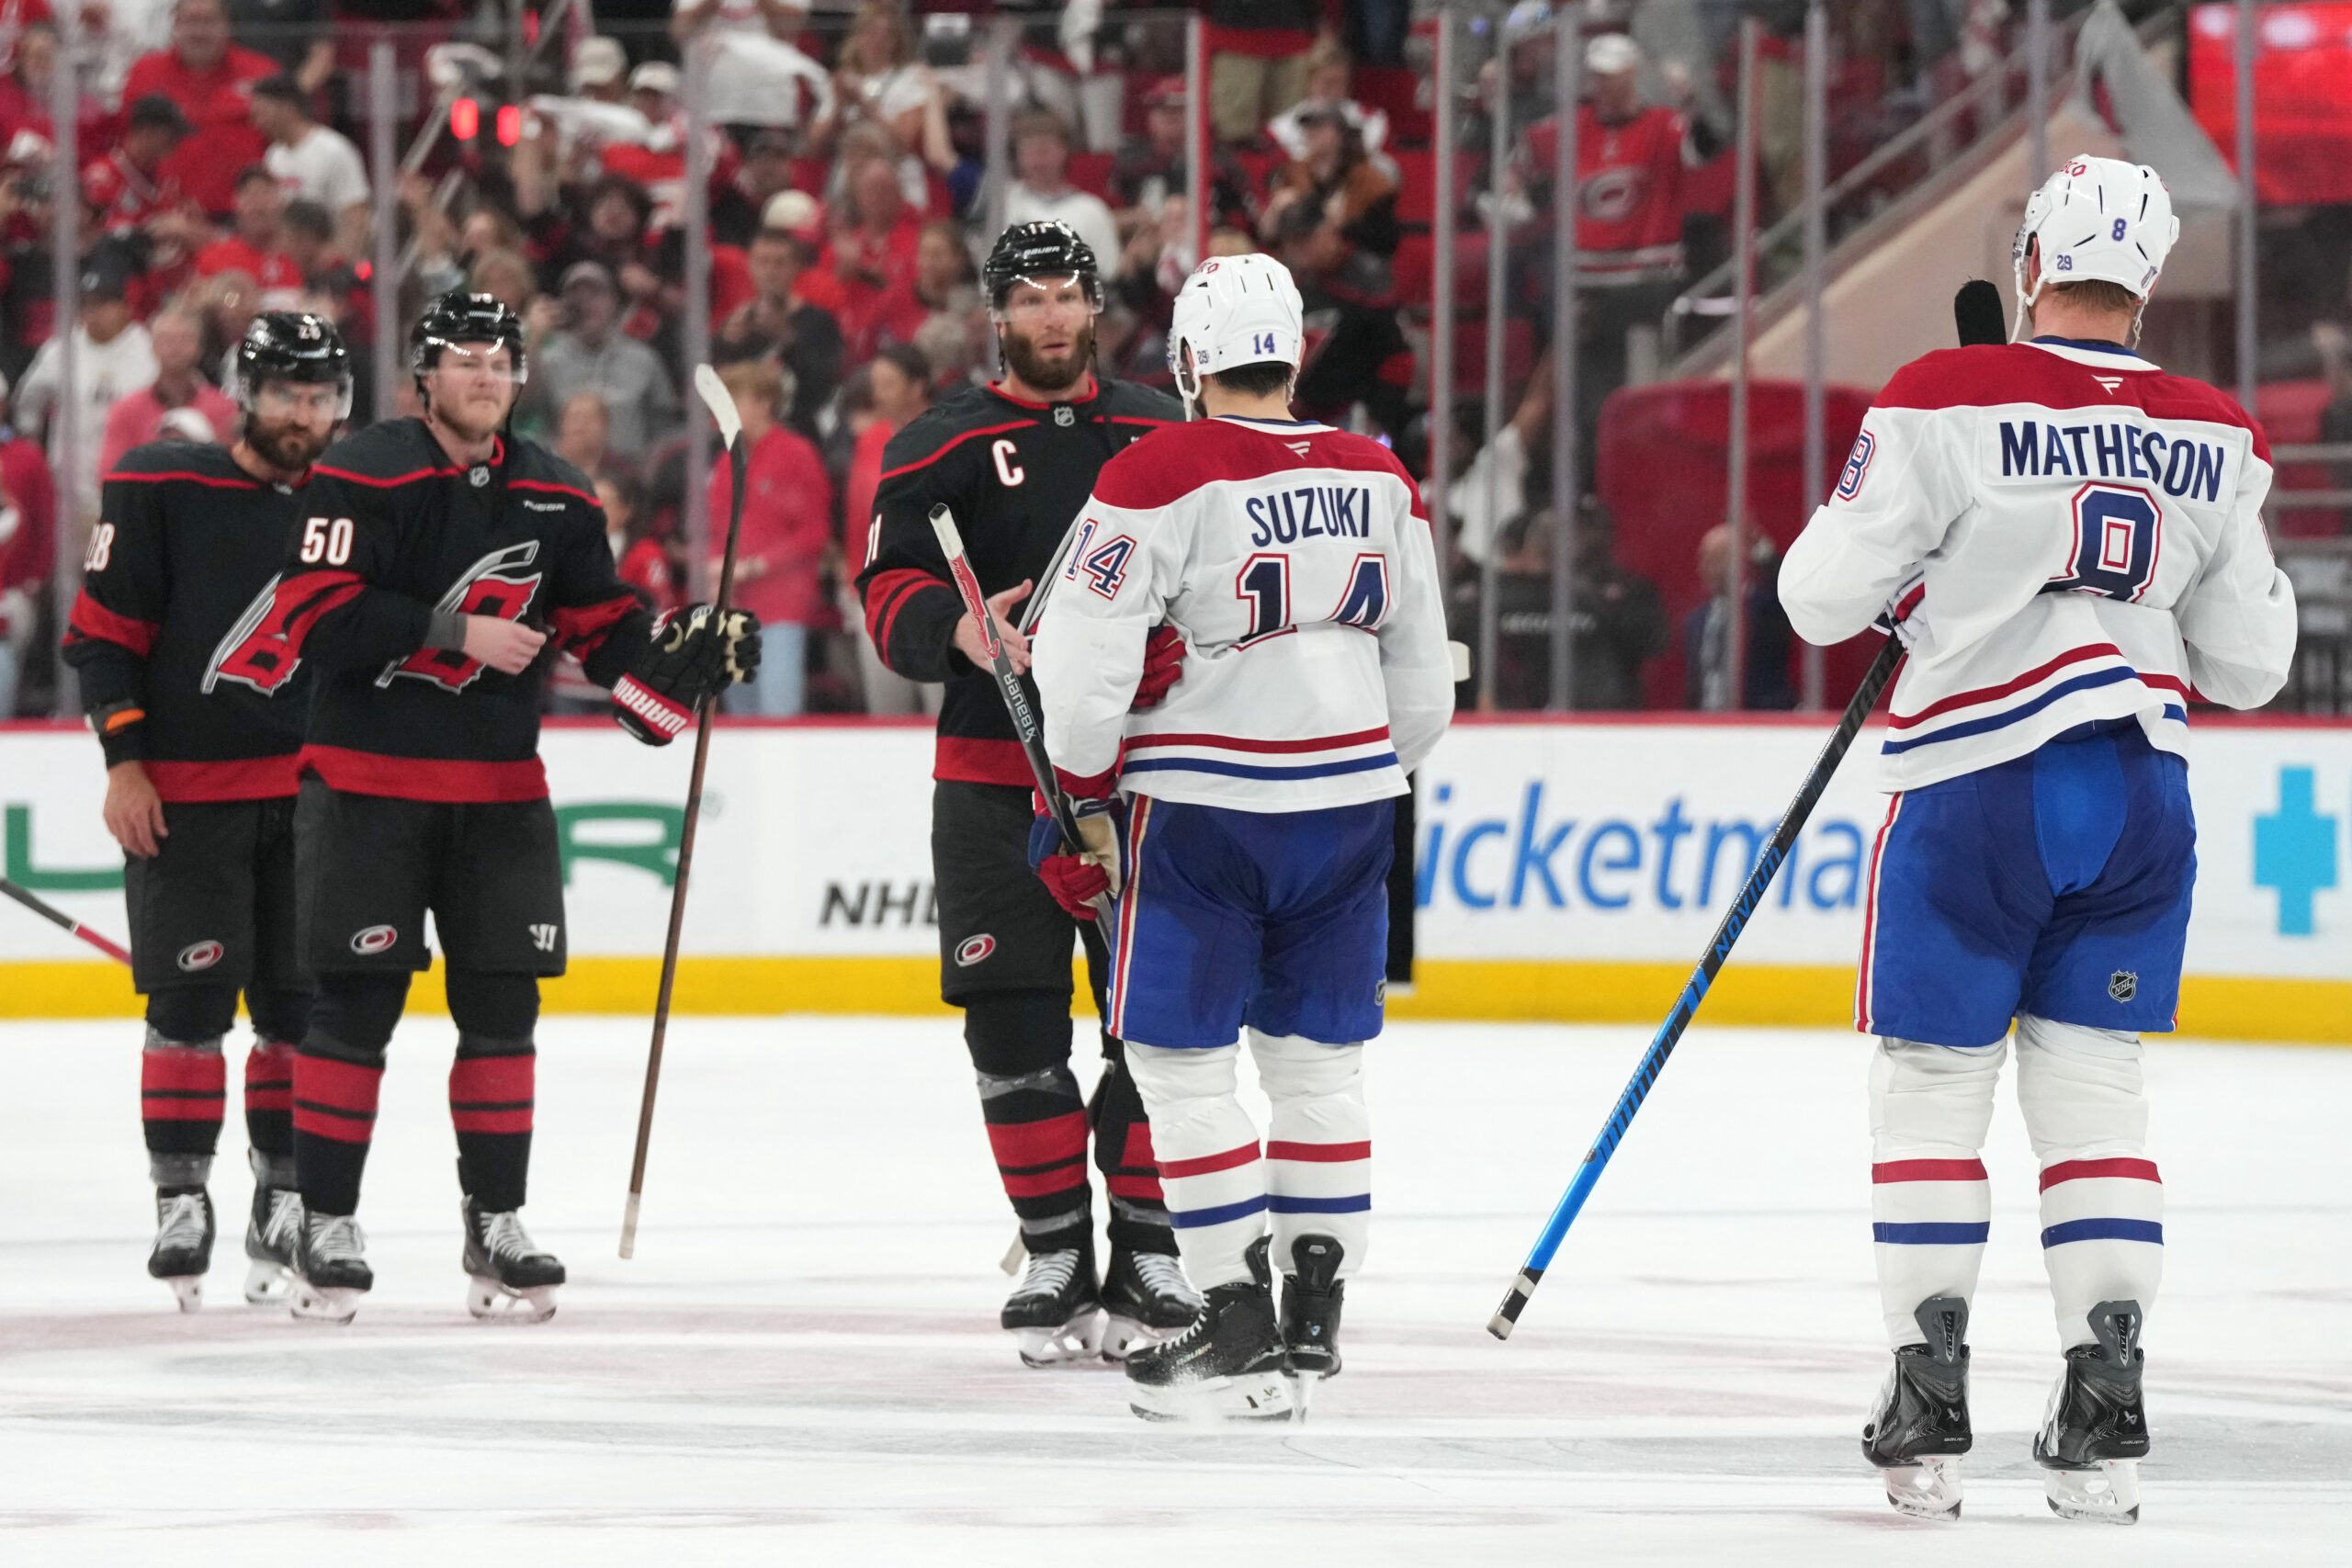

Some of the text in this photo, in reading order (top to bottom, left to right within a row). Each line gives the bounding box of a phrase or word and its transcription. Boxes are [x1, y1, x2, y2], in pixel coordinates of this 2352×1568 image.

[2112, 218, 2126, 242] 8
[2057, 254, 2073, 270] 29
[1253, 332, 1275, 355] 14
[992, 439, 1025, 487] C
[1837, 429, 1877, 502] 8
[1999, 421, 2224, 502] MATHESON
[300, 516, 355, 567] 50
[1247, 488, 1369, 547] SUZUKI
[1066, 517, 1137, 601] 14
[1003, 671, 1034, 728] BAUER
[1715, 846, 1782, 961] NOVIUM
[2115, 979, 2132, 995] NHL
